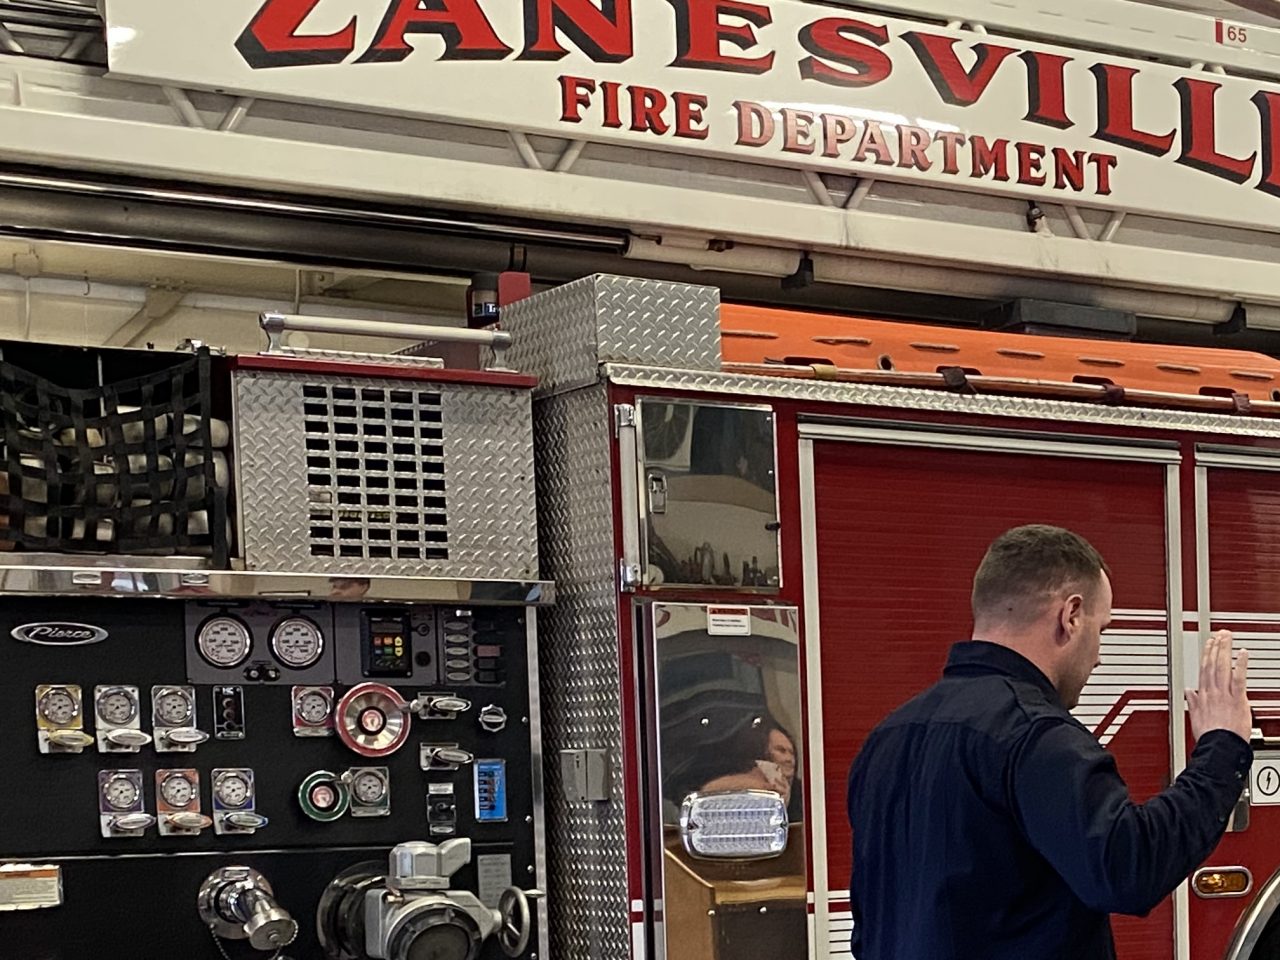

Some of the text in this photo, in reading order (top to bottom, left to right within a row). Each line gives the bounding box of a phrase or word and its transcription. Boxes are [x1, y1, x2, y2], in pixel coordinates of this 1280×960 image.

[1227, 26, 1247, 43] 65
[557, 75, 1118, 197] FIRE DEPARTMENT
[28, 626, 92, 638] Pierce
